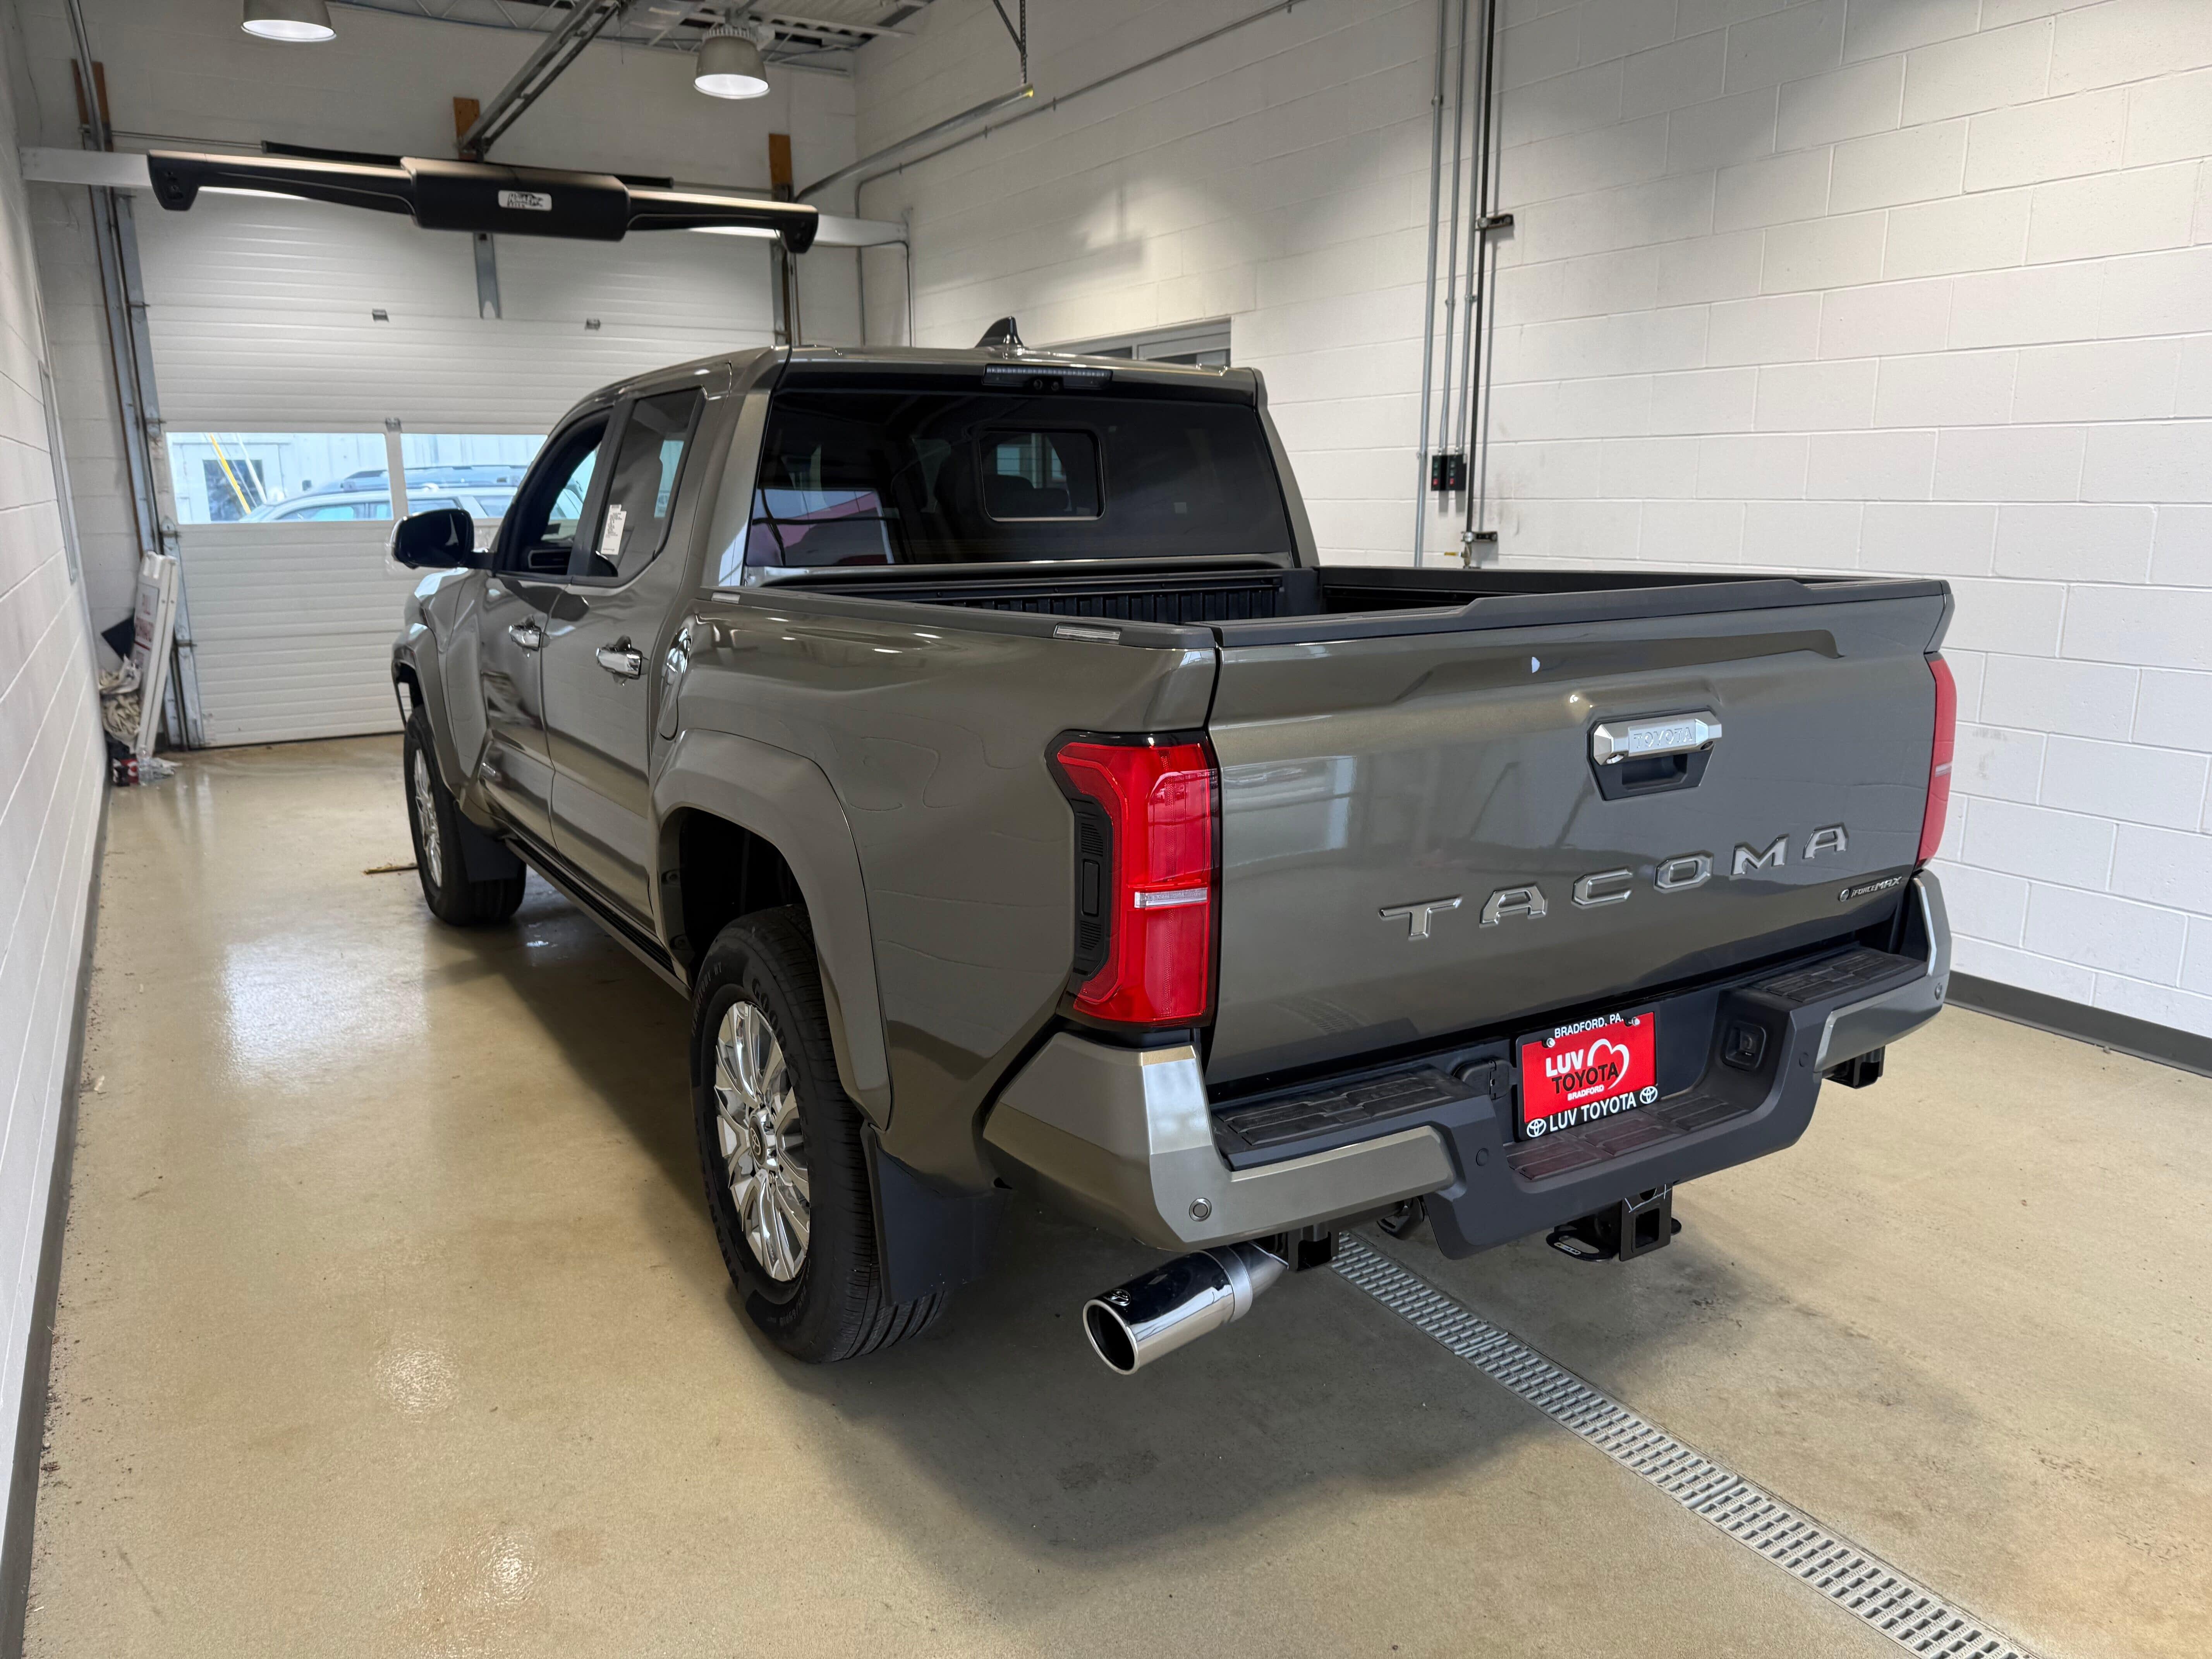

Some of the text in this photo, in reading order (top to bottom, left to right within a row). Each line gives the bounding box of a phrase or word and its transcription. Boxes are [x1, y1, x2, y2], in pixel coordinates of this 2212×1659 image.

[1633, 727, 1693, 748] TOYOTA
[1377, 822, 1850, 940] TACOMA
[1554, 1017, 1607, 1038] BRADFORD,
[1546, 1049, 1584, 1077] LUV
[1551, 1062, 1619, 1094] TOYOTA
[1567, 1084, 1604, 1101] BRADFORD
[1549, 1093, 1637, 1132] LUV TOYOTA
